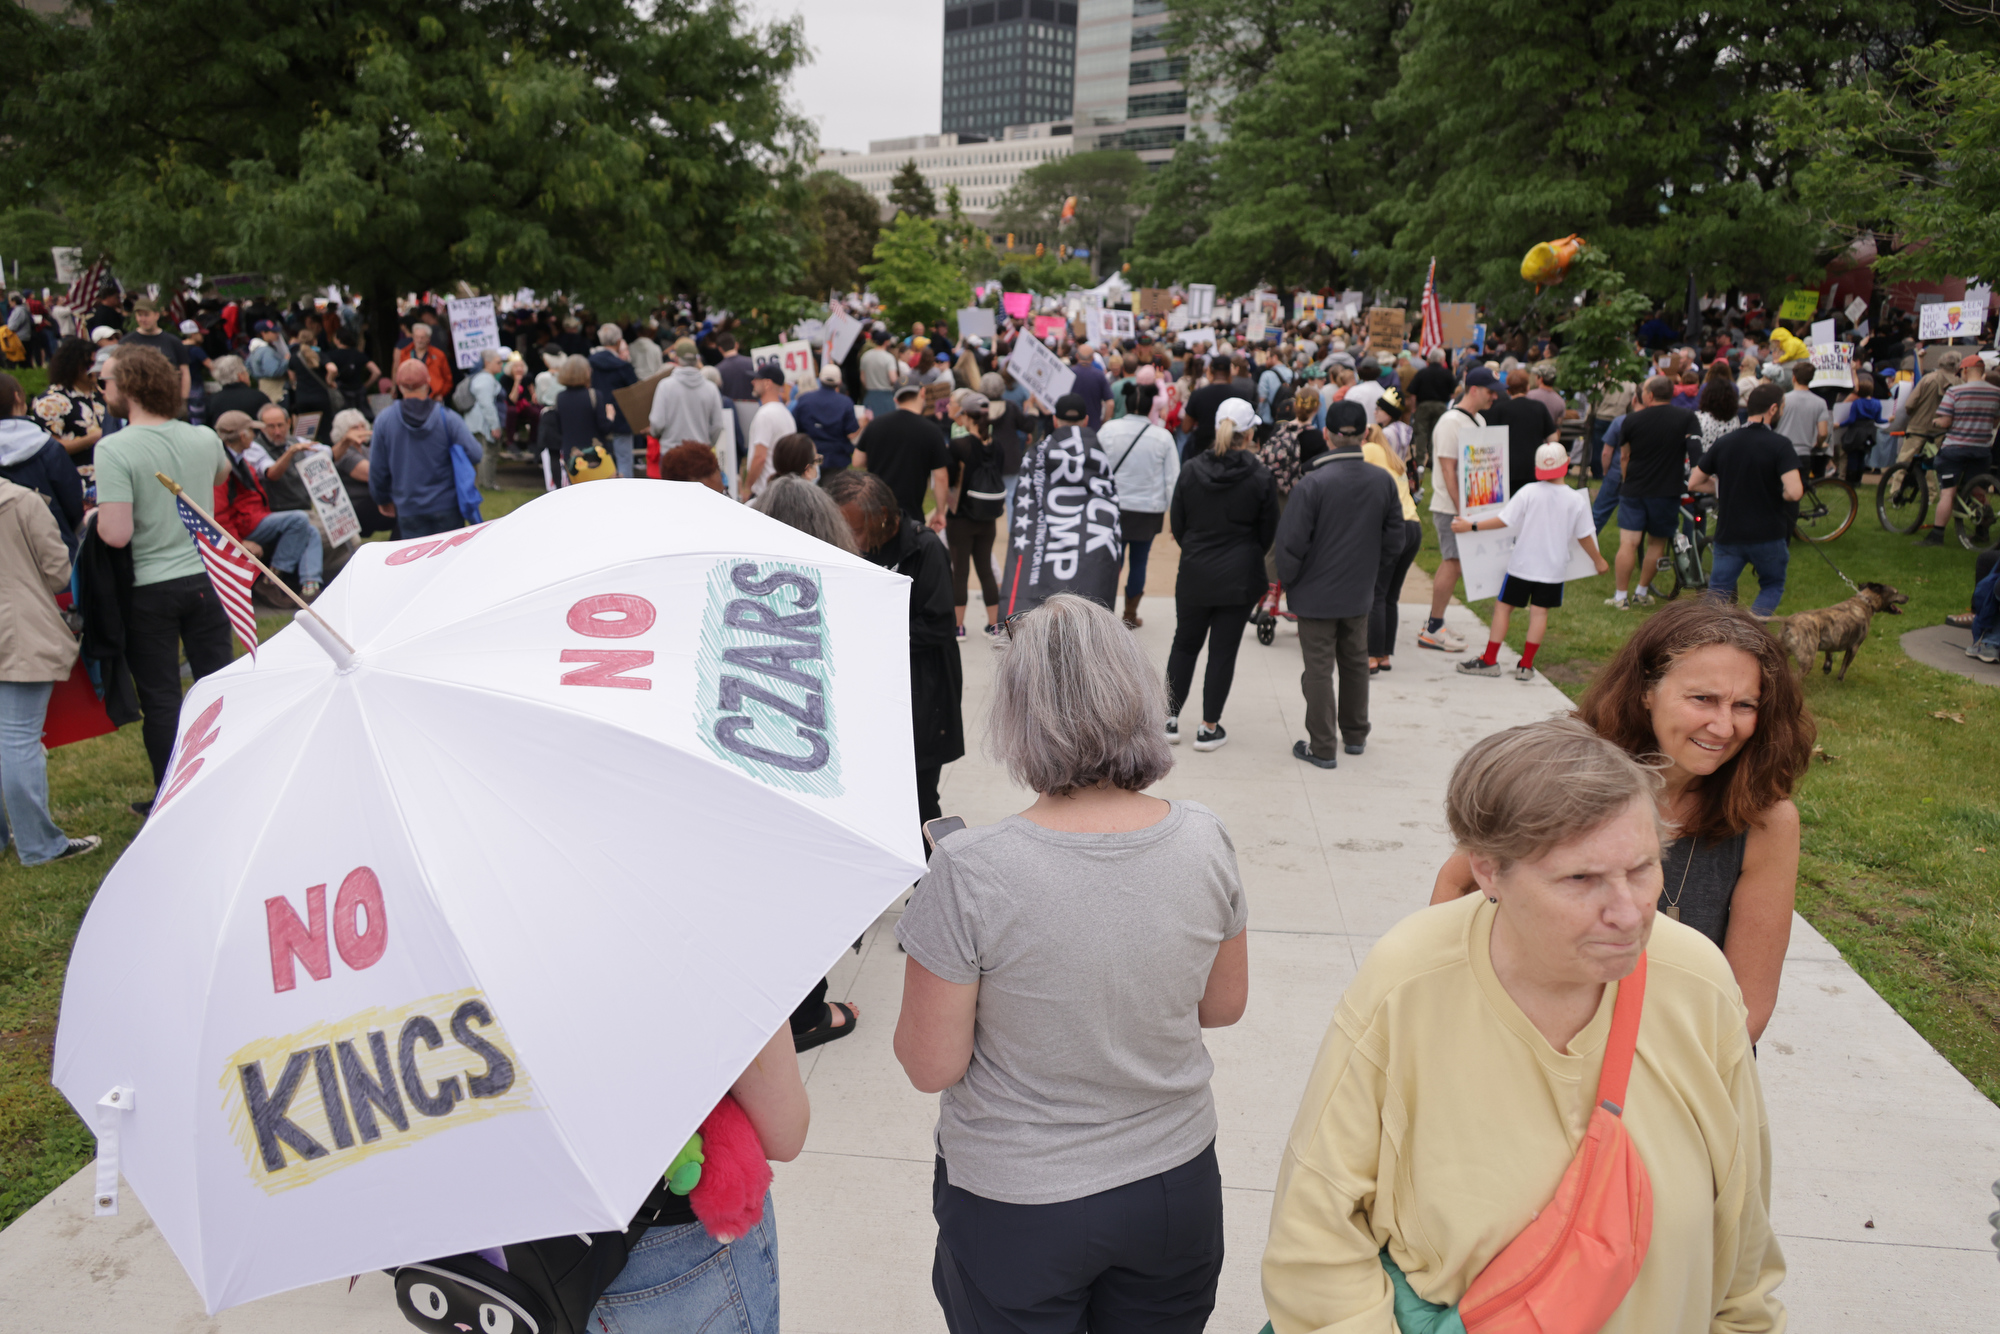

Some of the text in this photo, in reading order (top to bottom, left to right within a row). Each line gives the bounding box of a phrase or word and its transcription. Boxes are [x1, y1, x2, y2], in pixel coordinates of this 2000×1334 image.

[785, 350, 808, 371] 47
[1922, 320, 1937, 330] NO
[1032, 545, 1045, 567] FOR
[1044, 425, 1088, 581] TRUMP
[559, 592, 657, 691] NO
[714, 562, 830, 773] CZARS
[264, 865, 389, 994] NO
[237, 998, 516, 1174] KINGS
